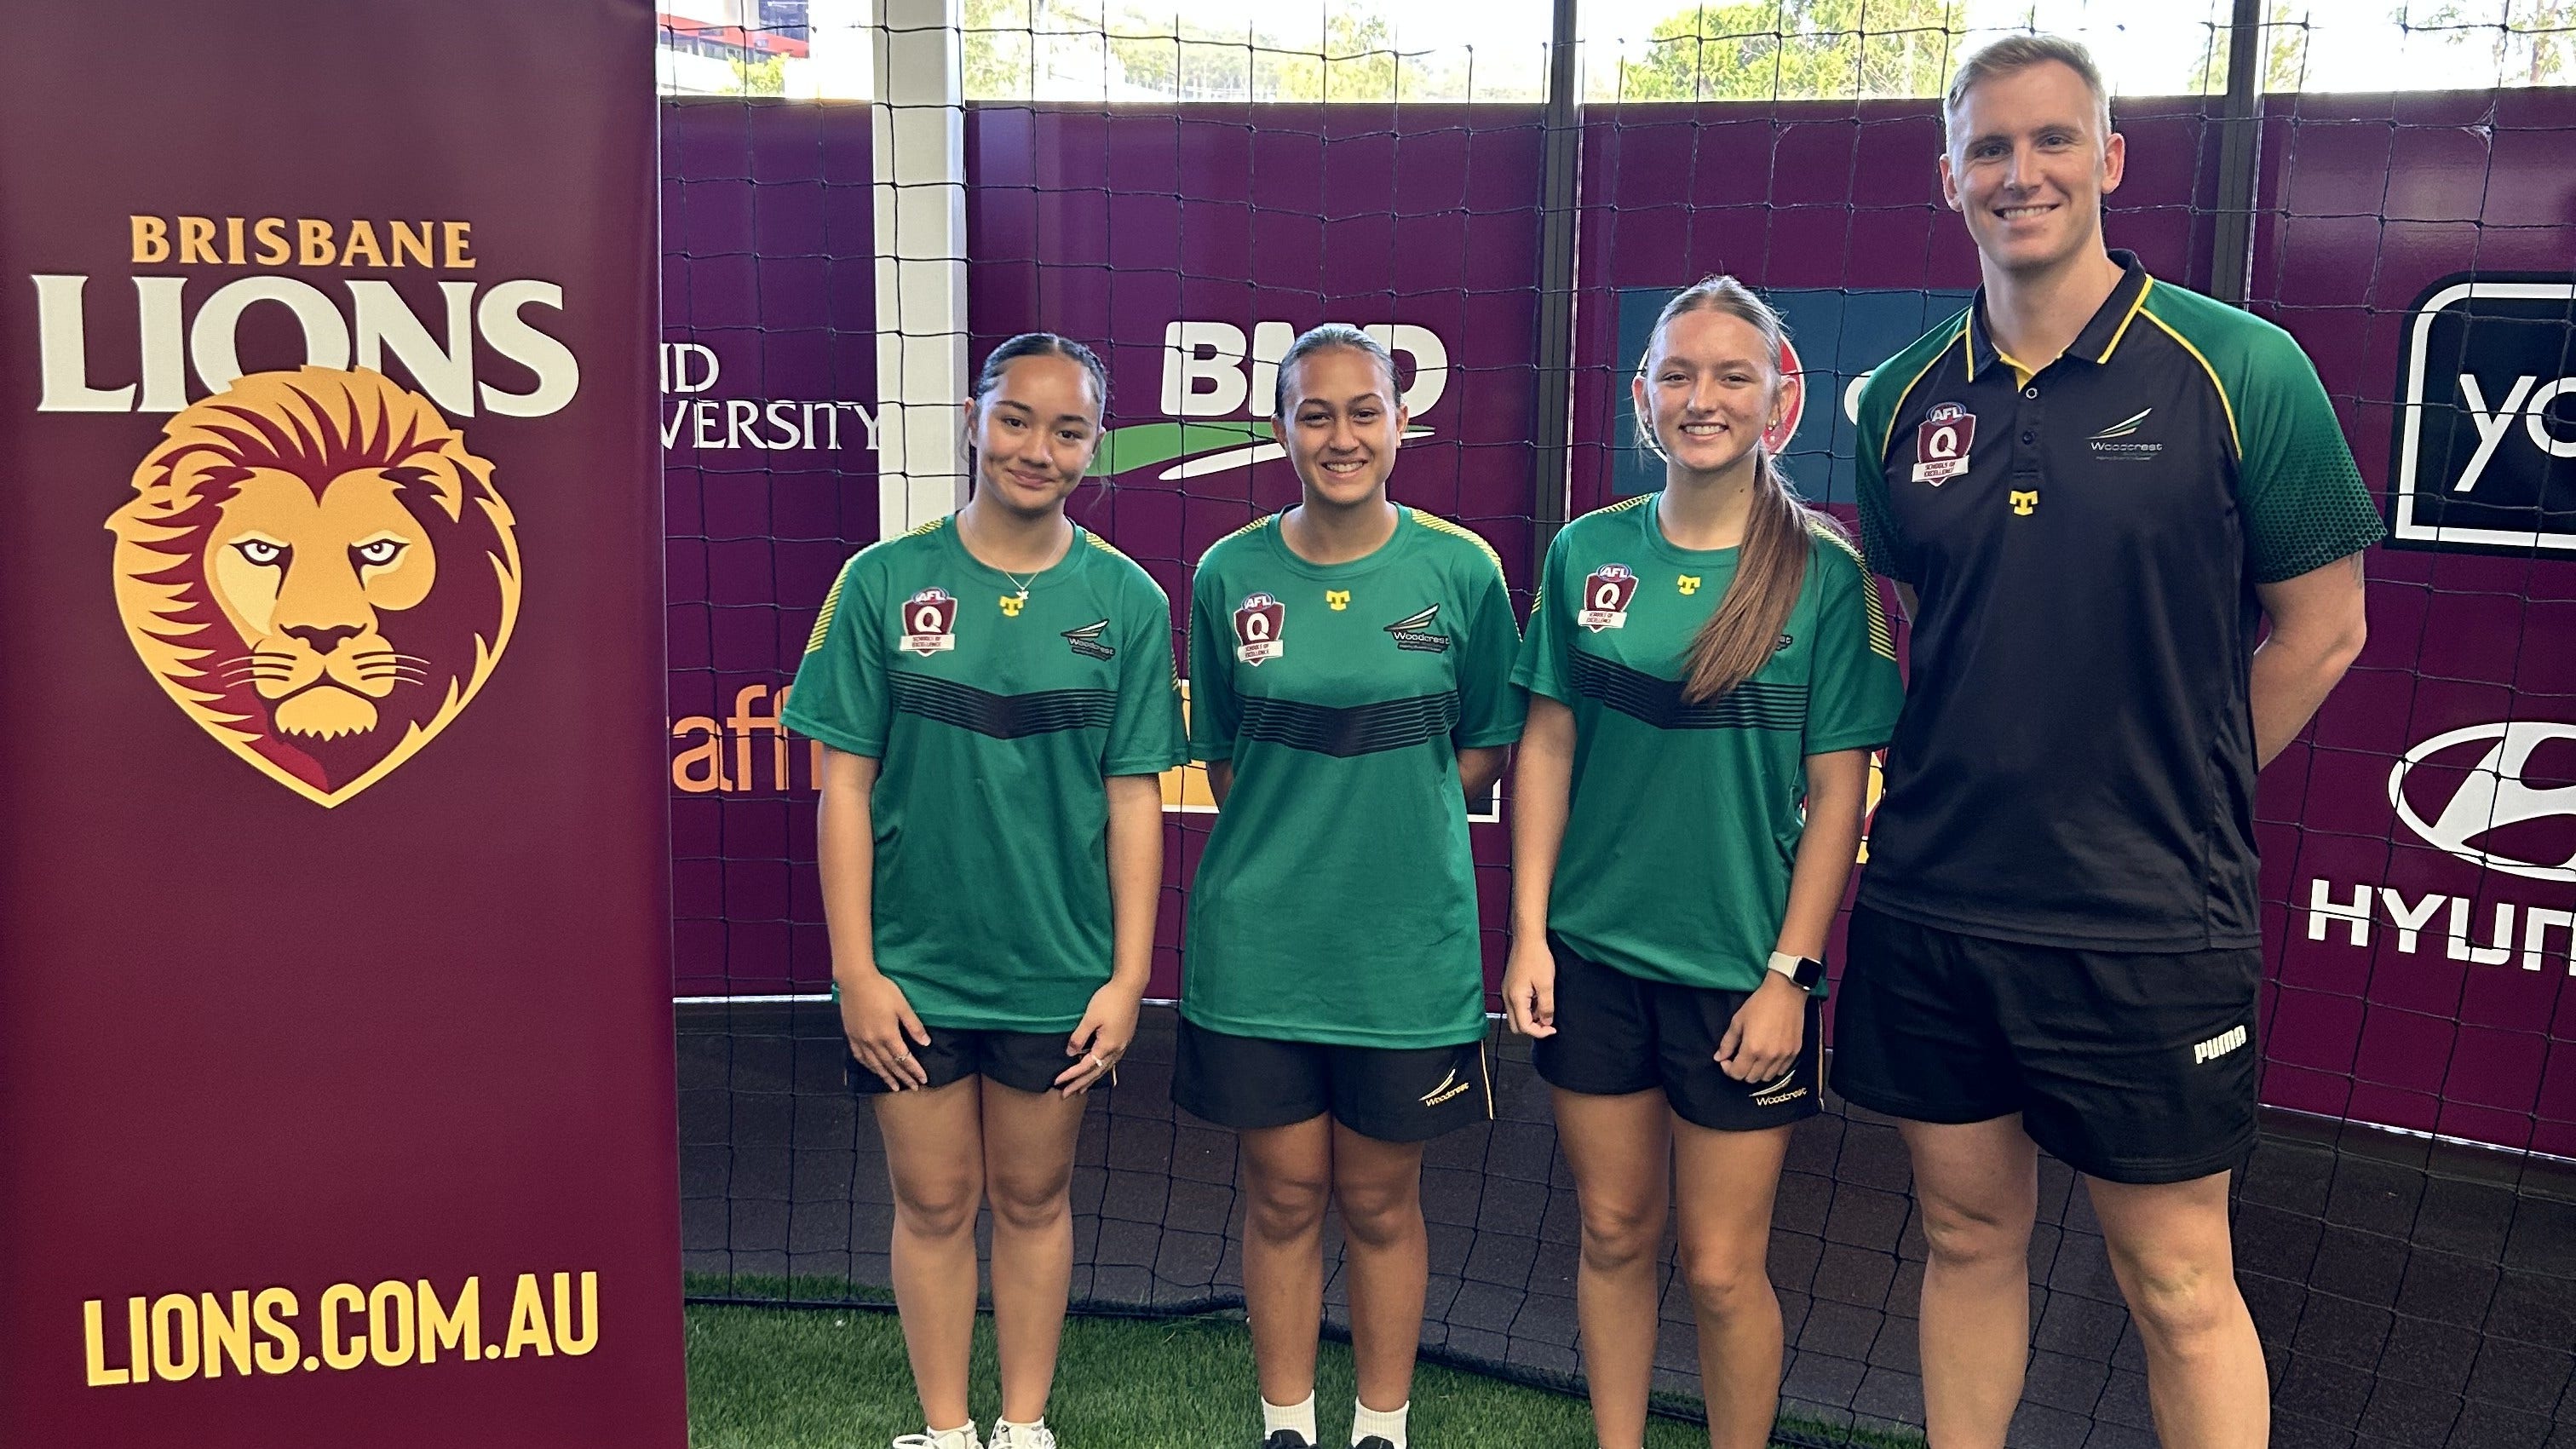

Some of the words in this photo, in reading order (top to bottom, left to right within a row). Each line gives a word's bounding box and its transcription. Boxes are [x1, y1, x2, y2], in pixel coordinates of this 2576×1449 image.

[130, 216, 476, 269] BRISBANE
[31, 274, 580, 418] LIONS
[1931, 406, 1963, 423] AFL
[1929, 426, 1958, 458] Q
[1599, 566, 1628, 578] AFL
[915, 589, 947, 602] AFL
[1245, 595, 1272, 609] AFL
[1595, 583, 1620, 610] Q
[915, 606, 943, 633] Q
[1246, 612, 1270, 641] Q
[1393, 631, 1451, 645] Woodcrest
[2194, 1025, 2247, 1064] PUMA
[1756, 1088, 1807, 1106] Woodcrest
[83, 1271, 599, 1387] LIONS.COM.AU
